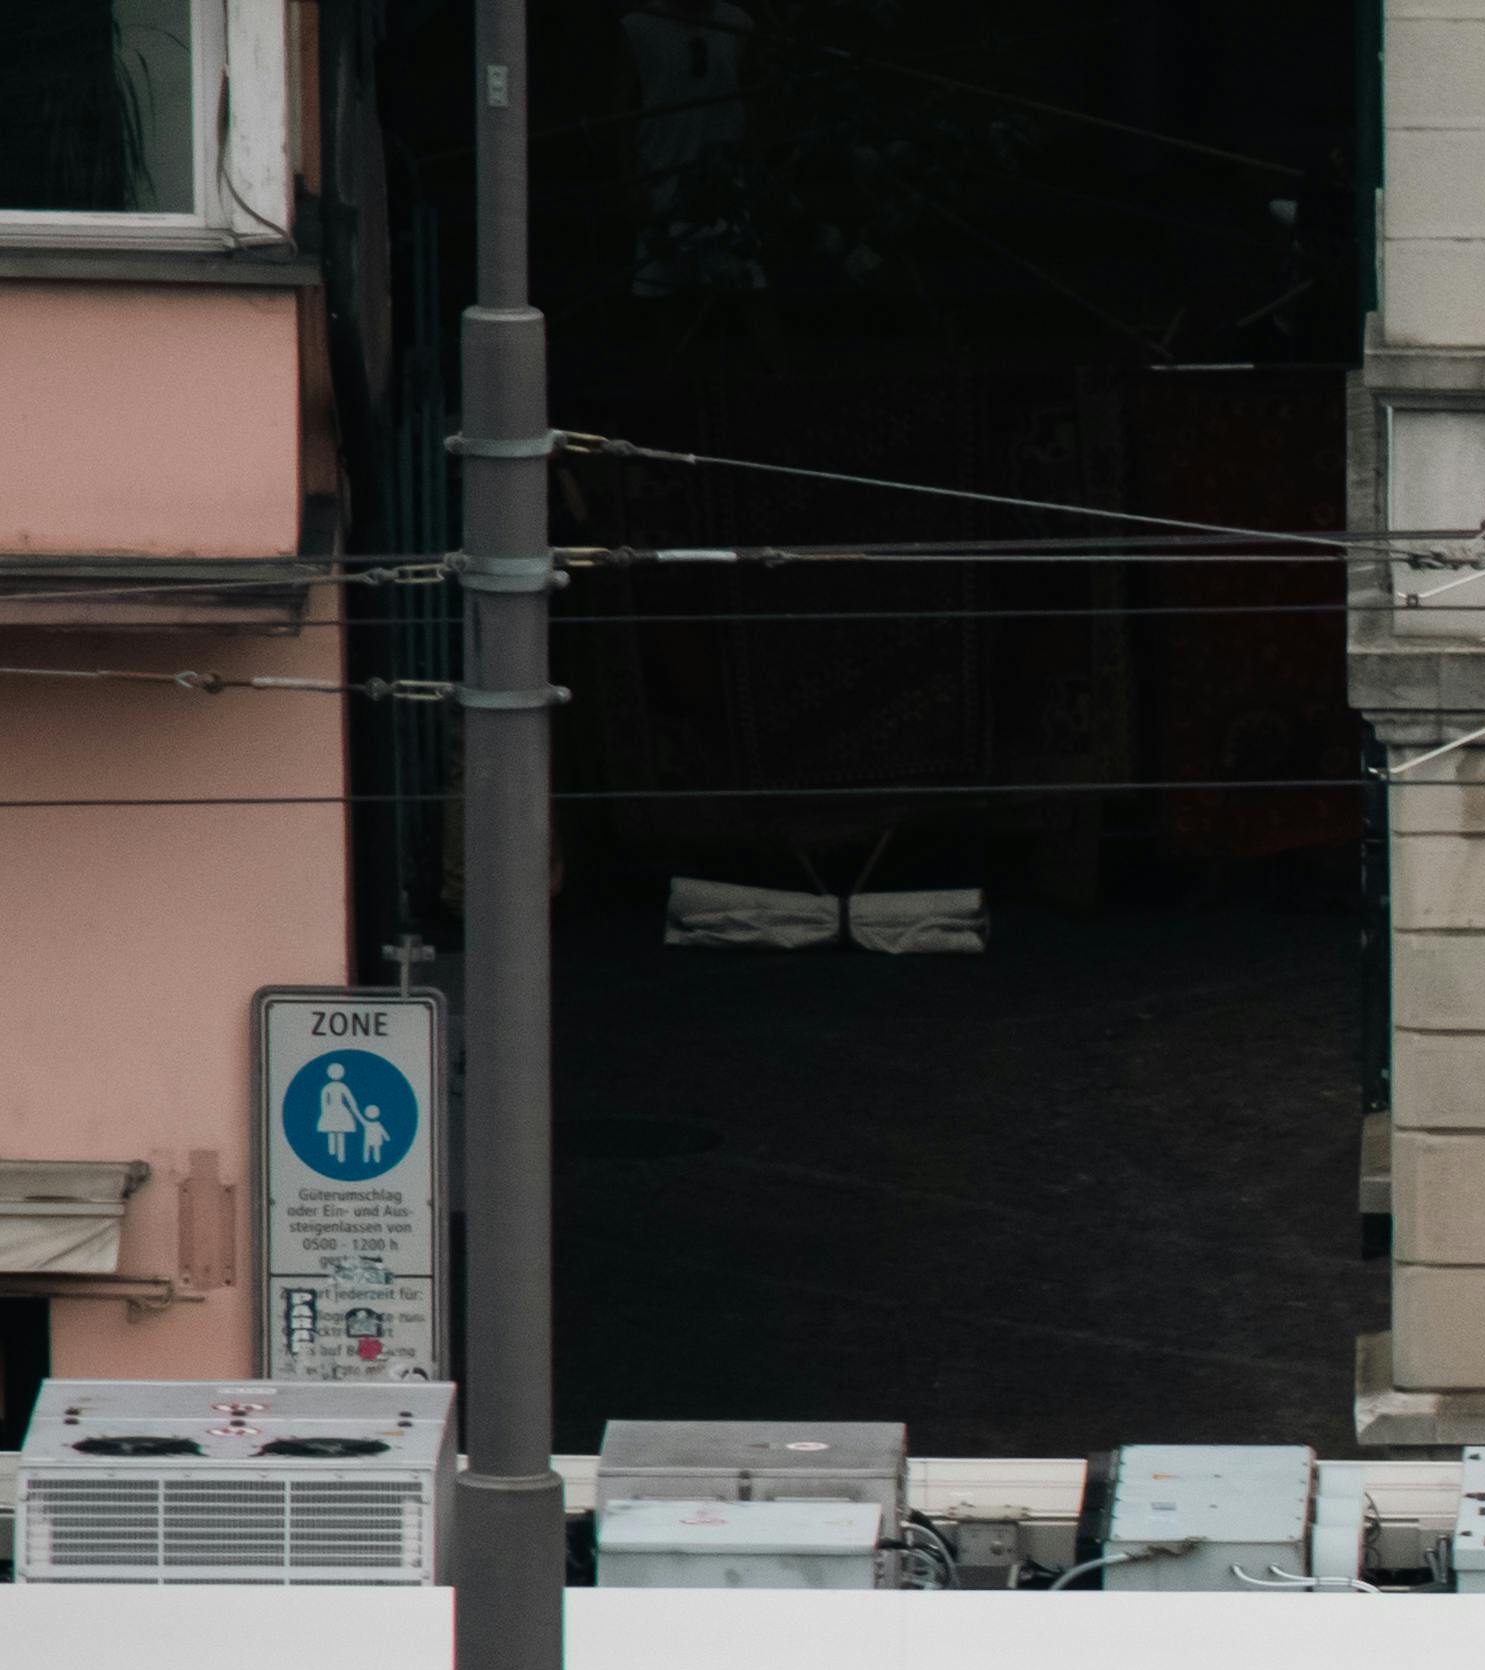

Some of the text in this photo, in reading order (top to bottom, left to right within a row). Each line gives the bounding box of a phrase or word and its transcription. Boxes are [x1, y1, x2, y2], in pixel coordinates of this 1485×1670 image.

[311, 1012, 388, 1037] ZONE
[287, 1204, 317, 1217] oder
[353, 1204, 379, 1217] und
[289, 1221, 413, 1236] steigenlassen von
